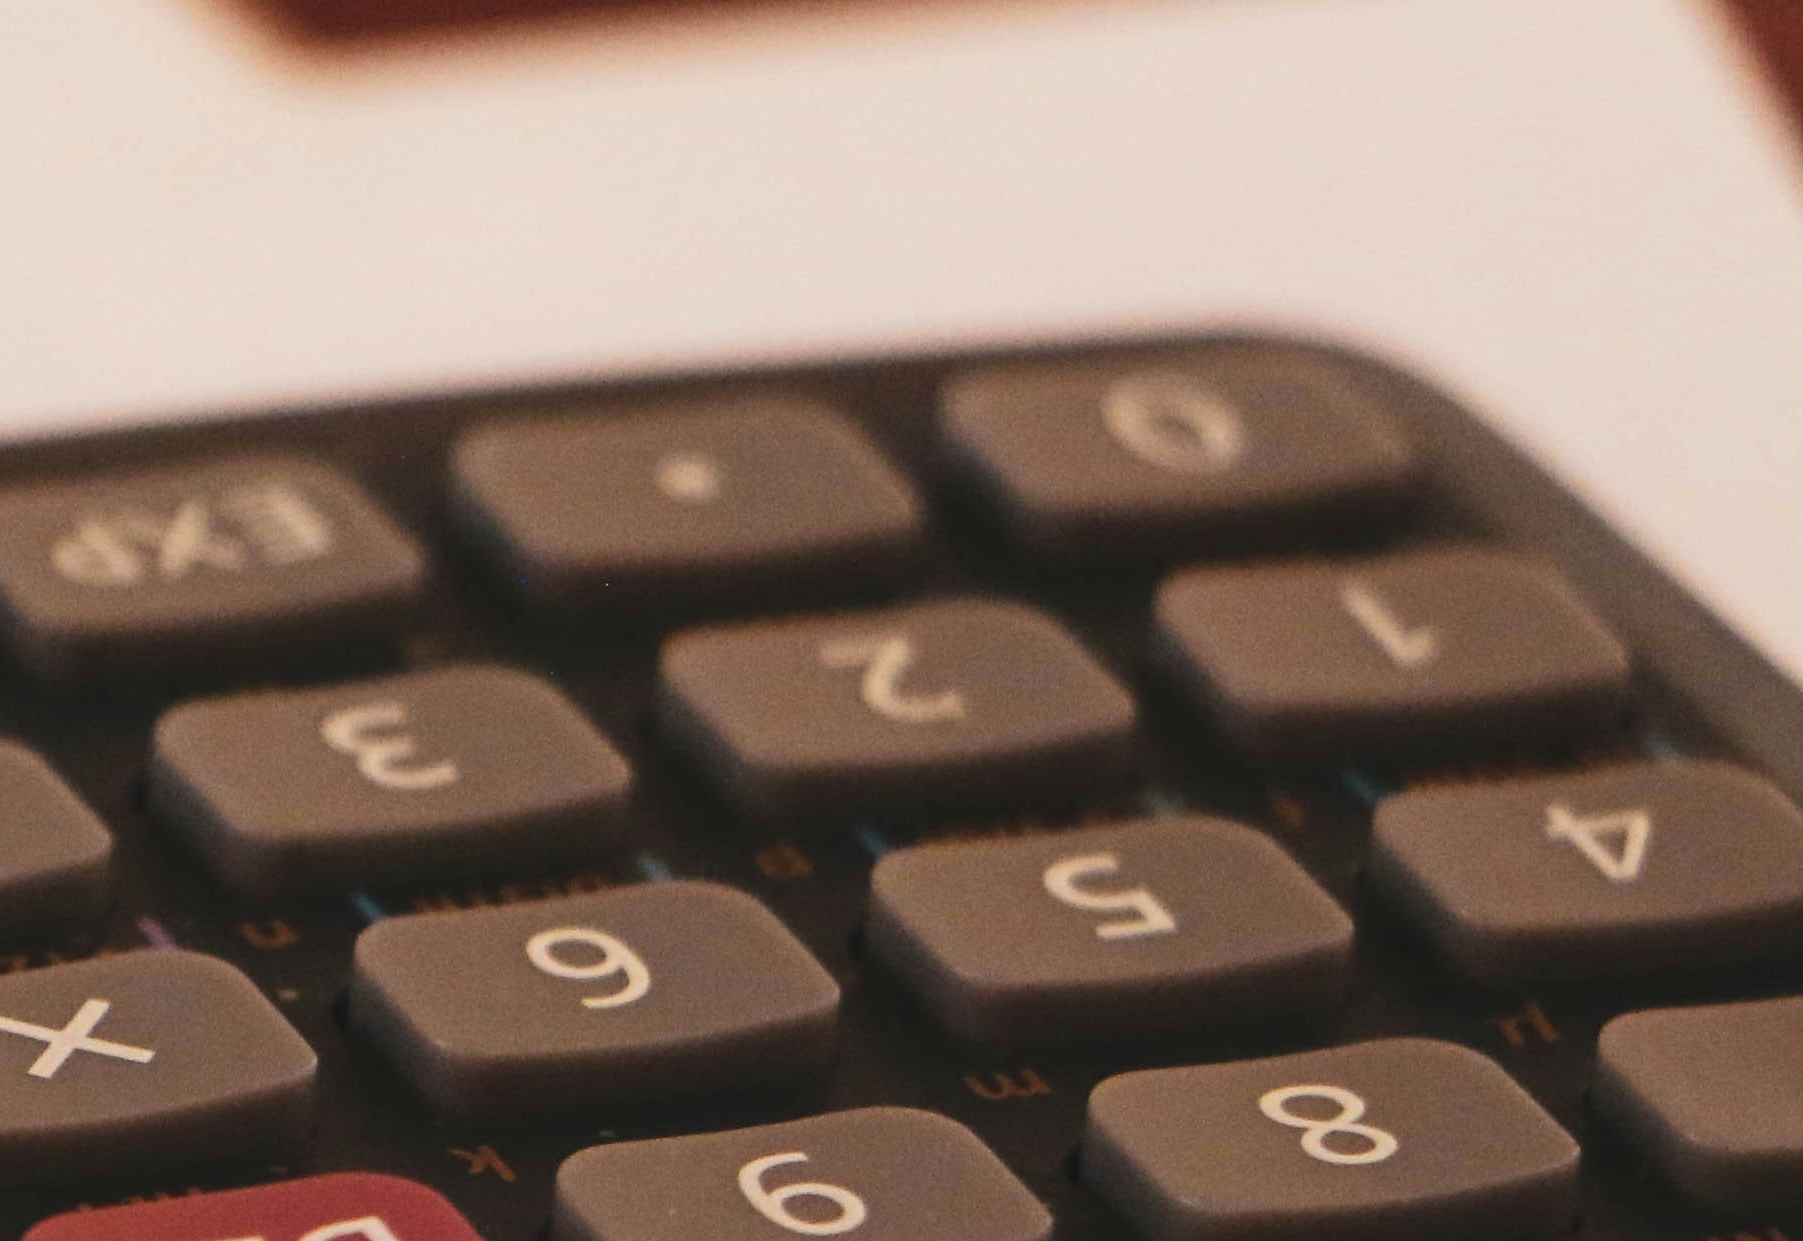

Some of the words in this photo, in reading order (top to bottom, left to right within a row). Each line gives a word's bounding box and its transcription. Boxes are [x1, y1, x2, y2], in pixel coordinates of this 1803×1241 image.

[1103, 373, 1244, 473] 0
[51, 489, 334, 592] EXP
[1337, 583, 1434, 668] 1
[819, 631, 966, 722] 2
[320, 702, 460, 789] 3
[1544, 803, 1651, 884] 4
[1042, 852, 1176, 939] 5
[527, 928, 651, 1008] 6
[1257, 1085, 1397, 1165] 8
[738, 1152, 867, 1236] 9
